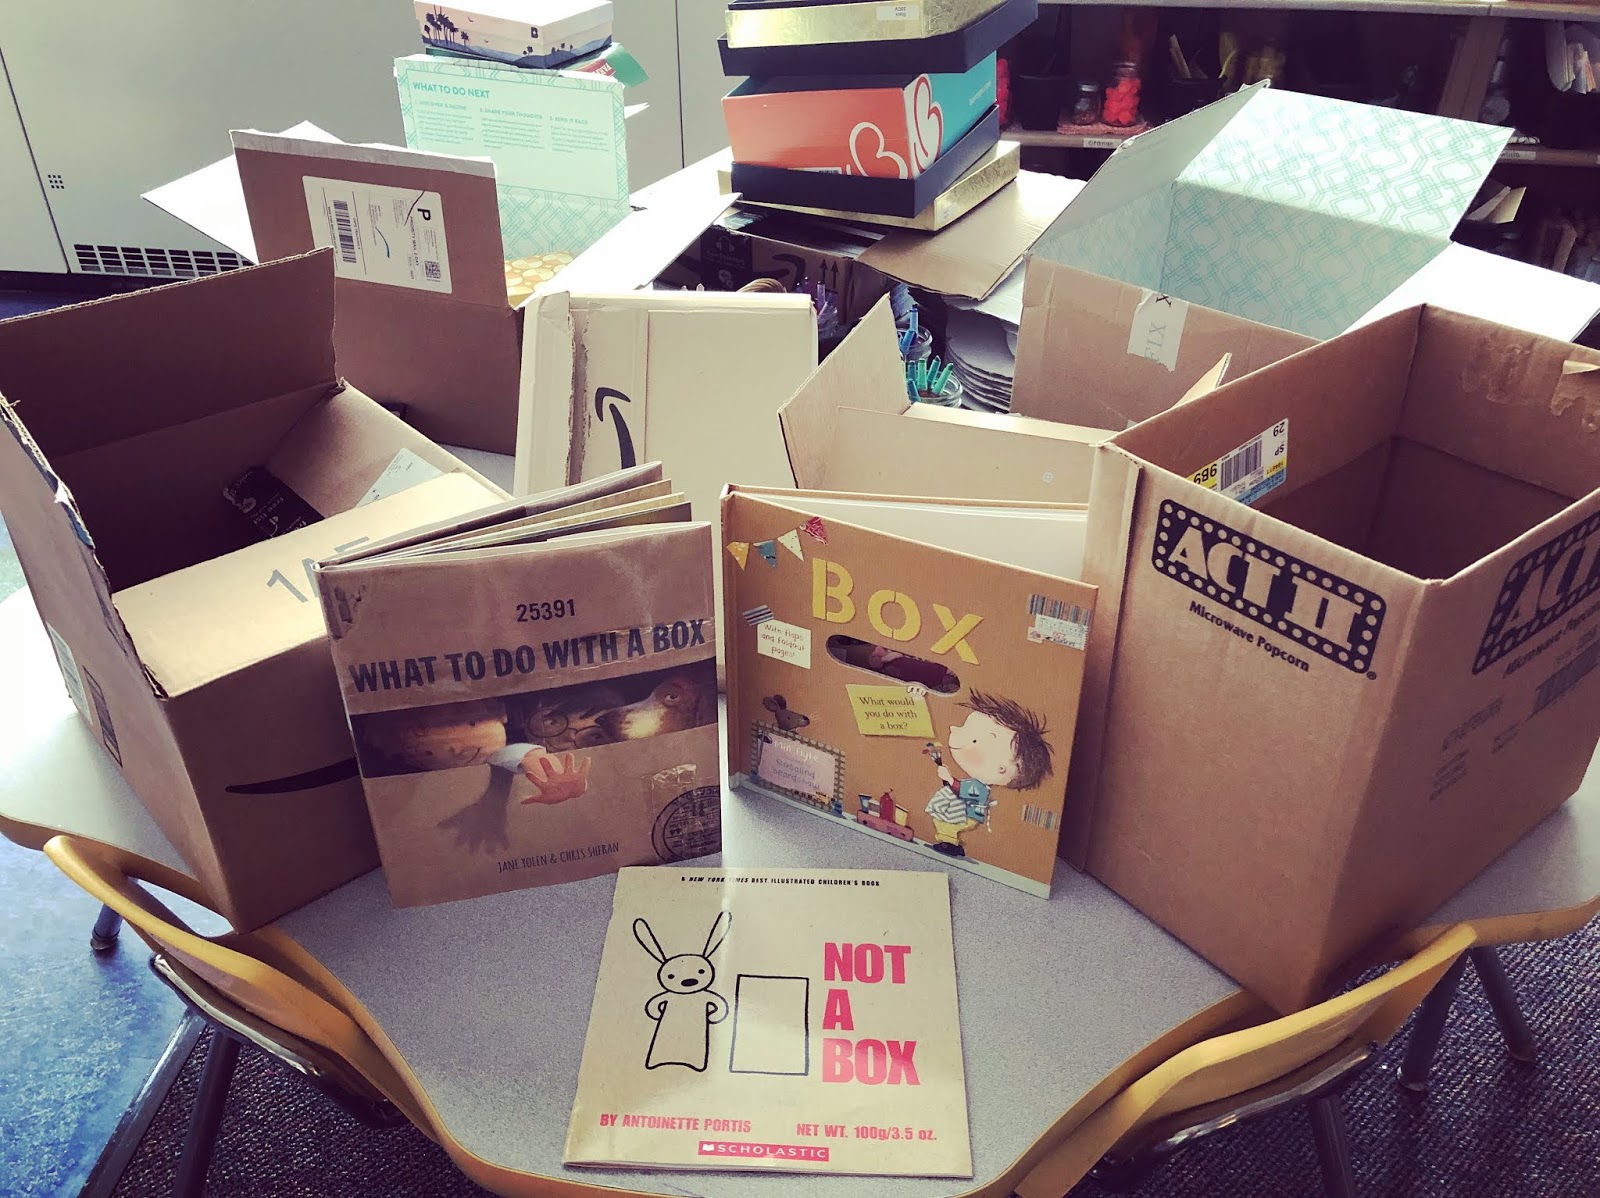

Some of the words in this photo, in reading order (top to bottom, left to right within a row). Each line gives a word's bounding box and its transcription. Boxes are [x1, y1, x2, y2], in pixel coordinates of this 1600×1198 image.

[530, 26, 539, 39] B
[412, 81, 437, 92] WHAT
[439, 84, 451, 94] TO
[453, 86, 466, 96] DO
[468, 88, 490, 99] NEXT
[417, 207, 431, 221] P
[1168, 526, 1286, 609] ACT
[1284, 575, 1364, 652] II
[515, 598, 577, 623] 25391
[812, 557, 984, 666] BOX
[761, 633, 775, 643] and
[764, 624, 782, 634] With
[785, 629, 804, 642] flaps
[1188, 600, 1254, 643] Microwave
[1256, 633, 1310, 673] Popcorn
[348, 655, 437, 693] WHAT
[444, 650, 487, 681] TO
[493, 645, 537, 678] DO
[542, 632, 619, 671] WITH
[627, 627, 646, 659] A
[652, 618, 706, 654] BOX
[858, 696, 885, 706] What
[887, 697, 915, 706] would
[864, 710, 881, 720] you
[882, 709, 895, 718] do
[897, 709, 918, 719] with
[886, 721, 908, 730] box?
[498, 859, 519, 874] JANE
[521, 854, 548, 869] YOLEN
[549, 853, 557, 864] &
[560, 849, 586, 863] CHRIS
[587, 842, 620, 858] SHEBAN
[823, 941, 912, 984] NOT
[821, 988, 855, 1031] A
[821, 1037, 922, 1086] BOX
[599, 1113, 619, 1127] BY
[621, 1114, 701, 1132] ANTOINETTE
[703, 1118, 752, 1134] PORTIS
[796, 1123, 820, 1138] NET
[823, 1124, 850, 1140] WT.
[853, 1125, 914, 1141] 100g/3.5
[917, 1129, 938, 1141] oz.
[716, 1143, 827, 1159] SCHOLASTIC
